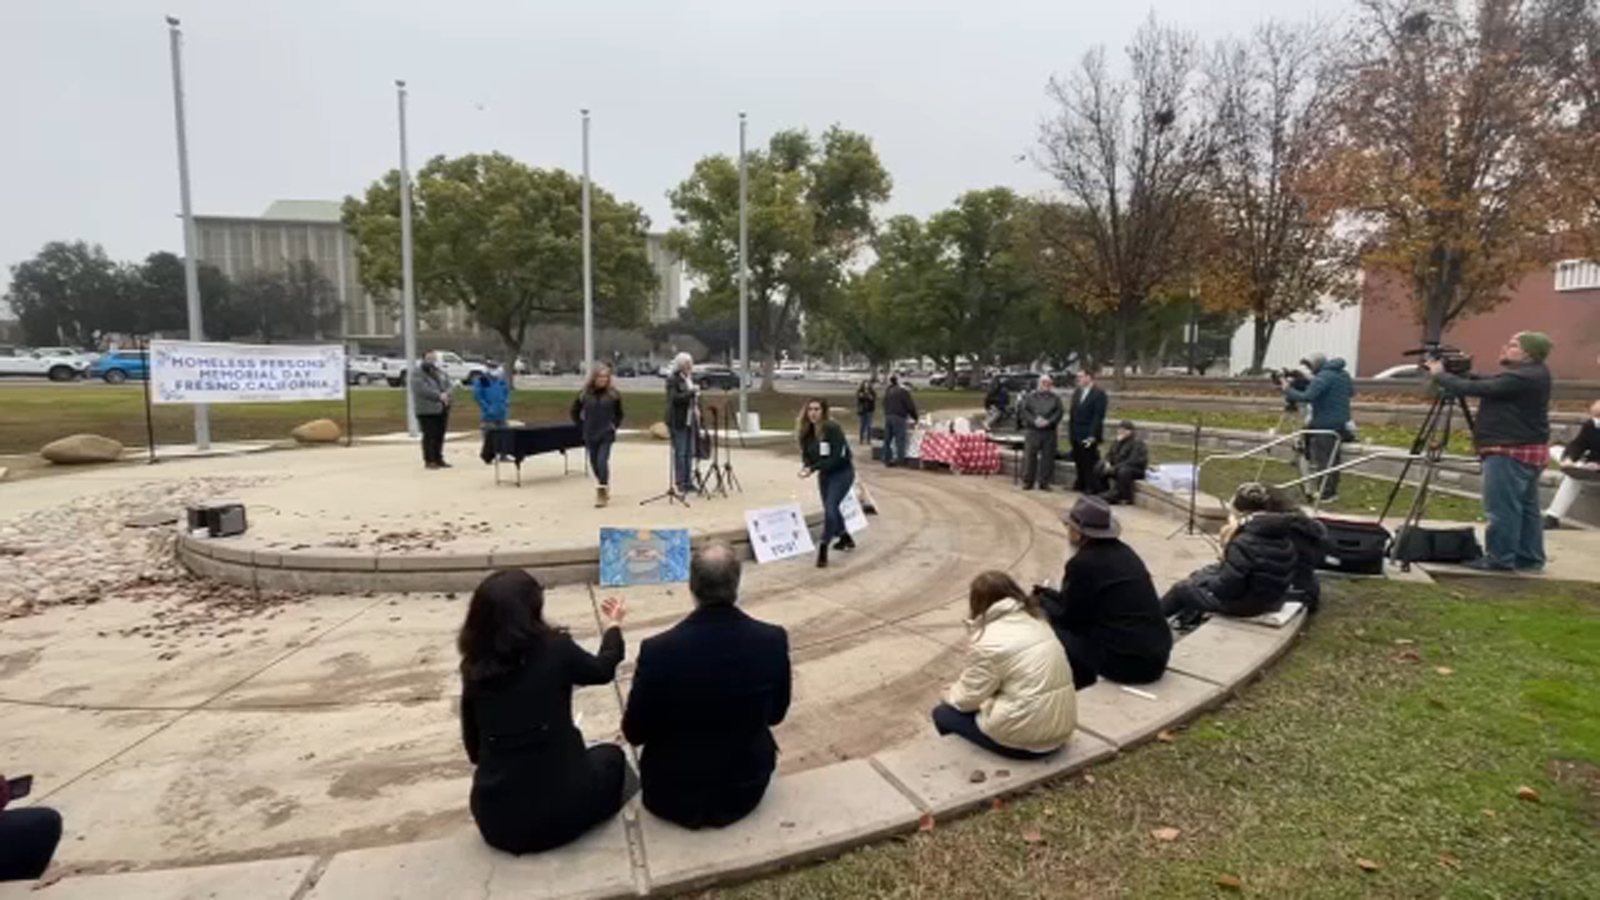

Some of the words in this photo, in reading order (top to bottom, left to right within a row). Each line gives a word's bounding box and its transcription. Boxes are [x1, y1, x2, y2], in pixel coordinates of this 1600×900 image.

[171, 357, 255, 368] HOMELESS
[199, 369, 277, 380] MEMORIAL
[282, 370, 311, 379] DAY
[248, 380, 328, 390] CALIFORNIA
